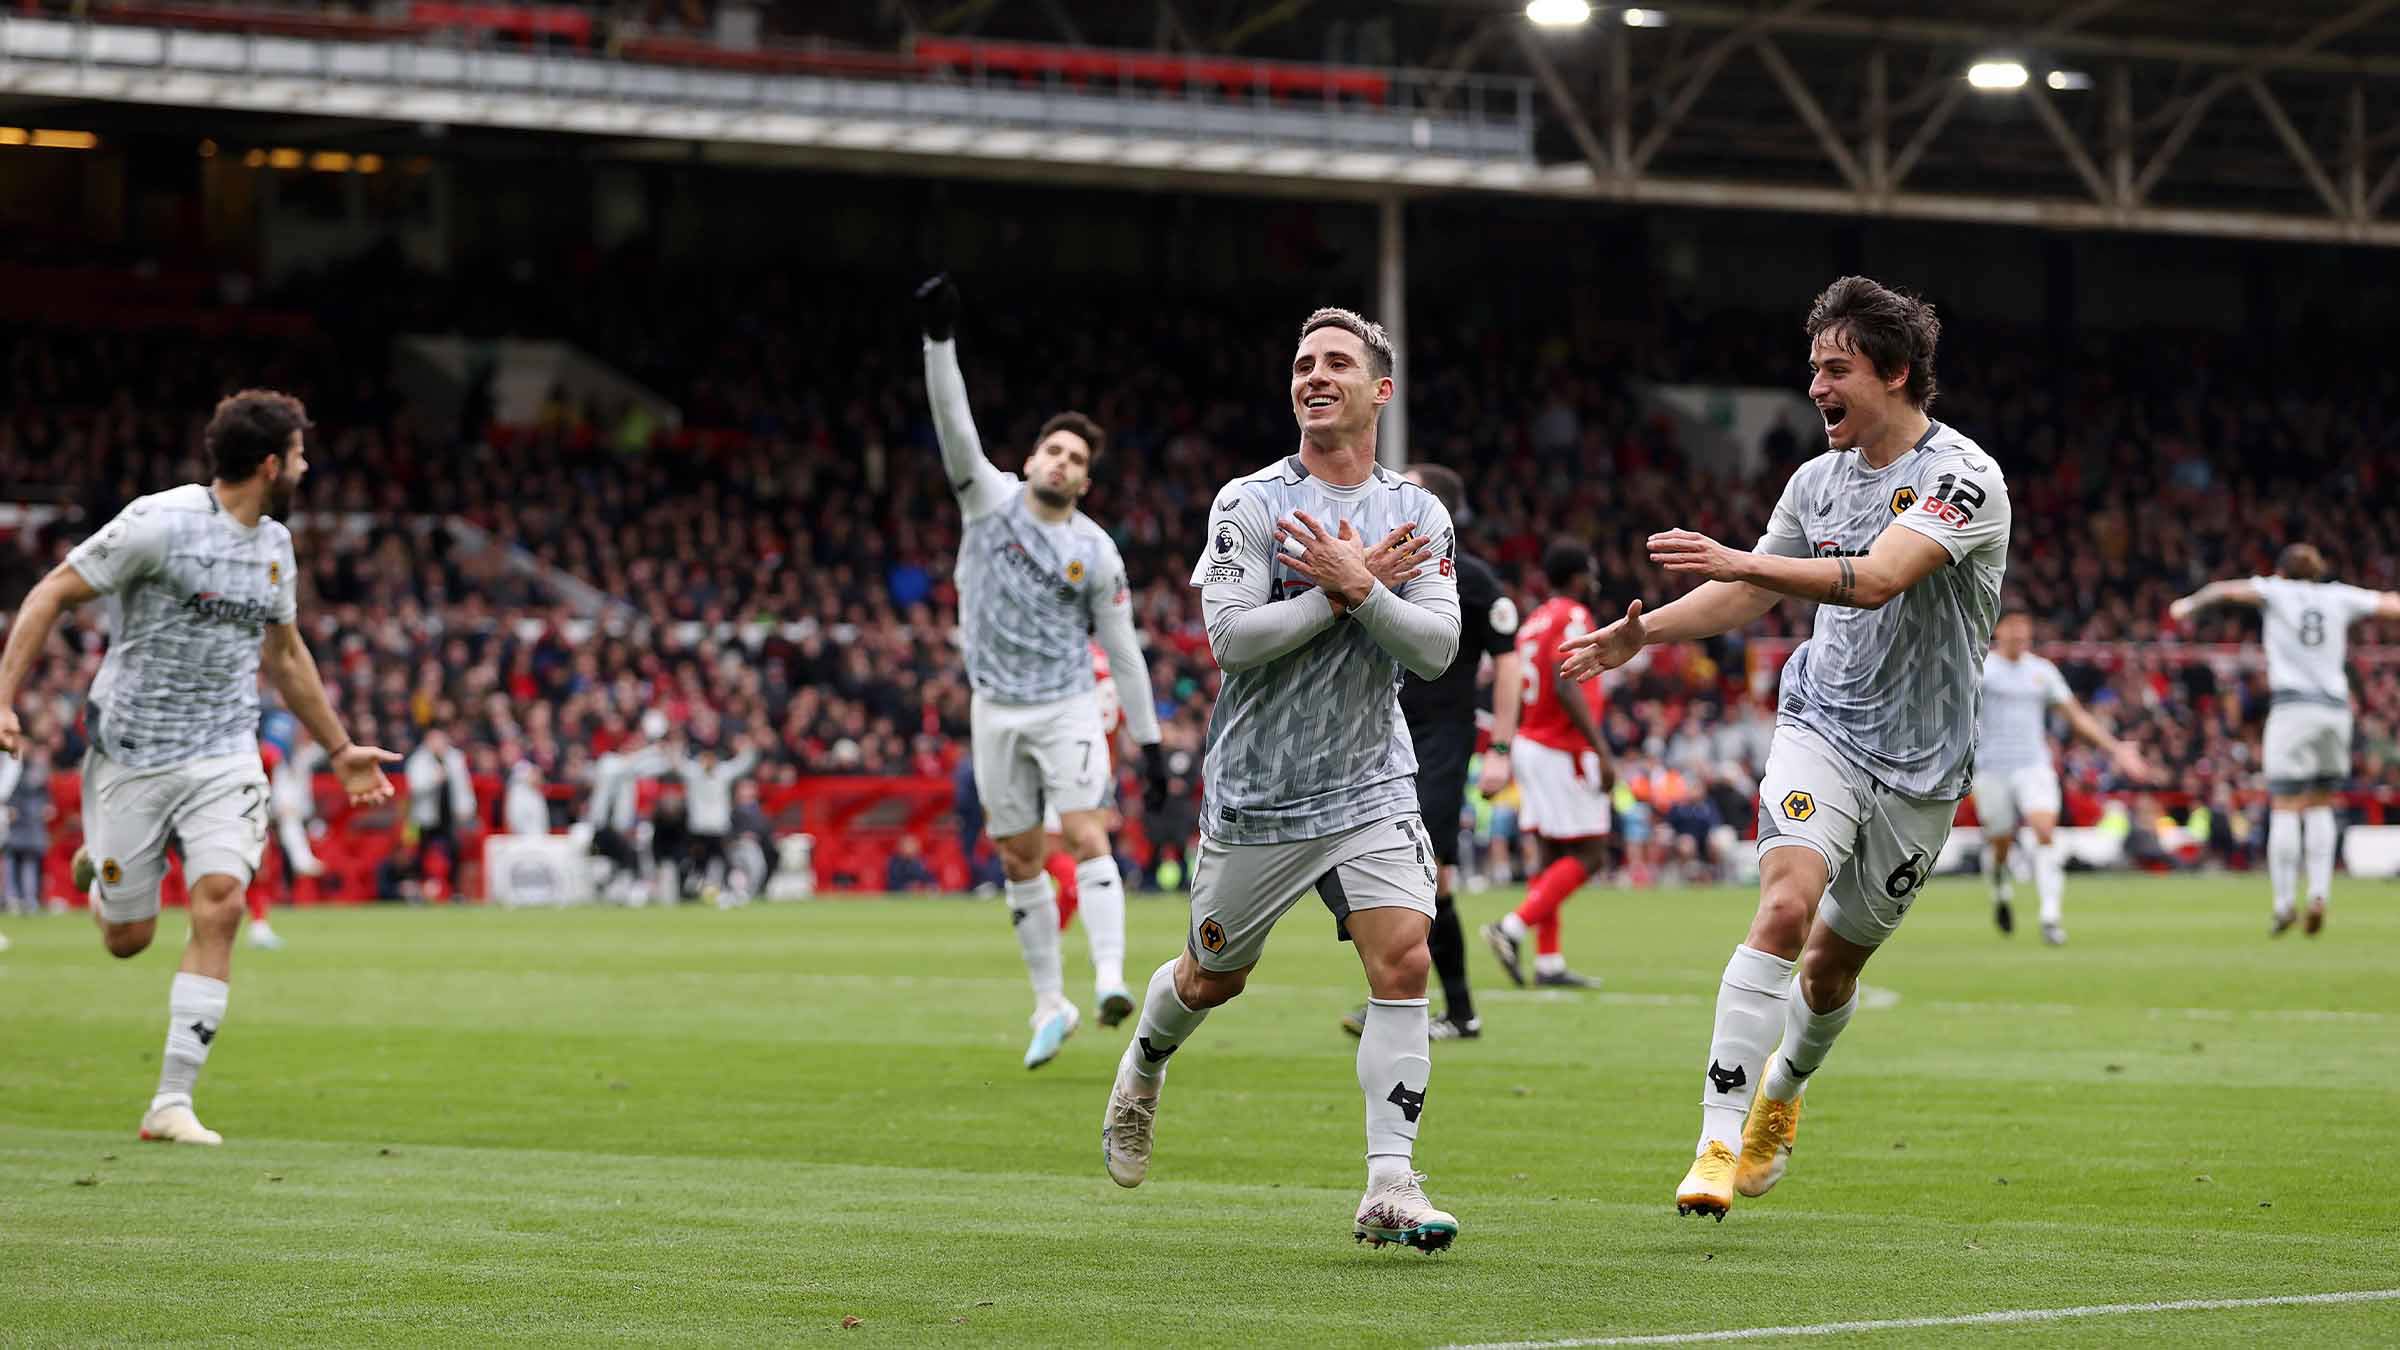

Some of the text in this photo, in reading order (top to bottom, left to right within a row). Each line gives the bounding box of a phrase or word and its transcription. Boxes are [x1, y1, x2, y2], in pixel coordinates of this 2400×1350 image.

[1922, 496, 1969, 528] BET
[1936, 473, 1986, 521] 12
[1215, 567, 1240, 577] room
[2299, 608, 2325, 648] 8
[1075, 740, 1091, 772] 7
